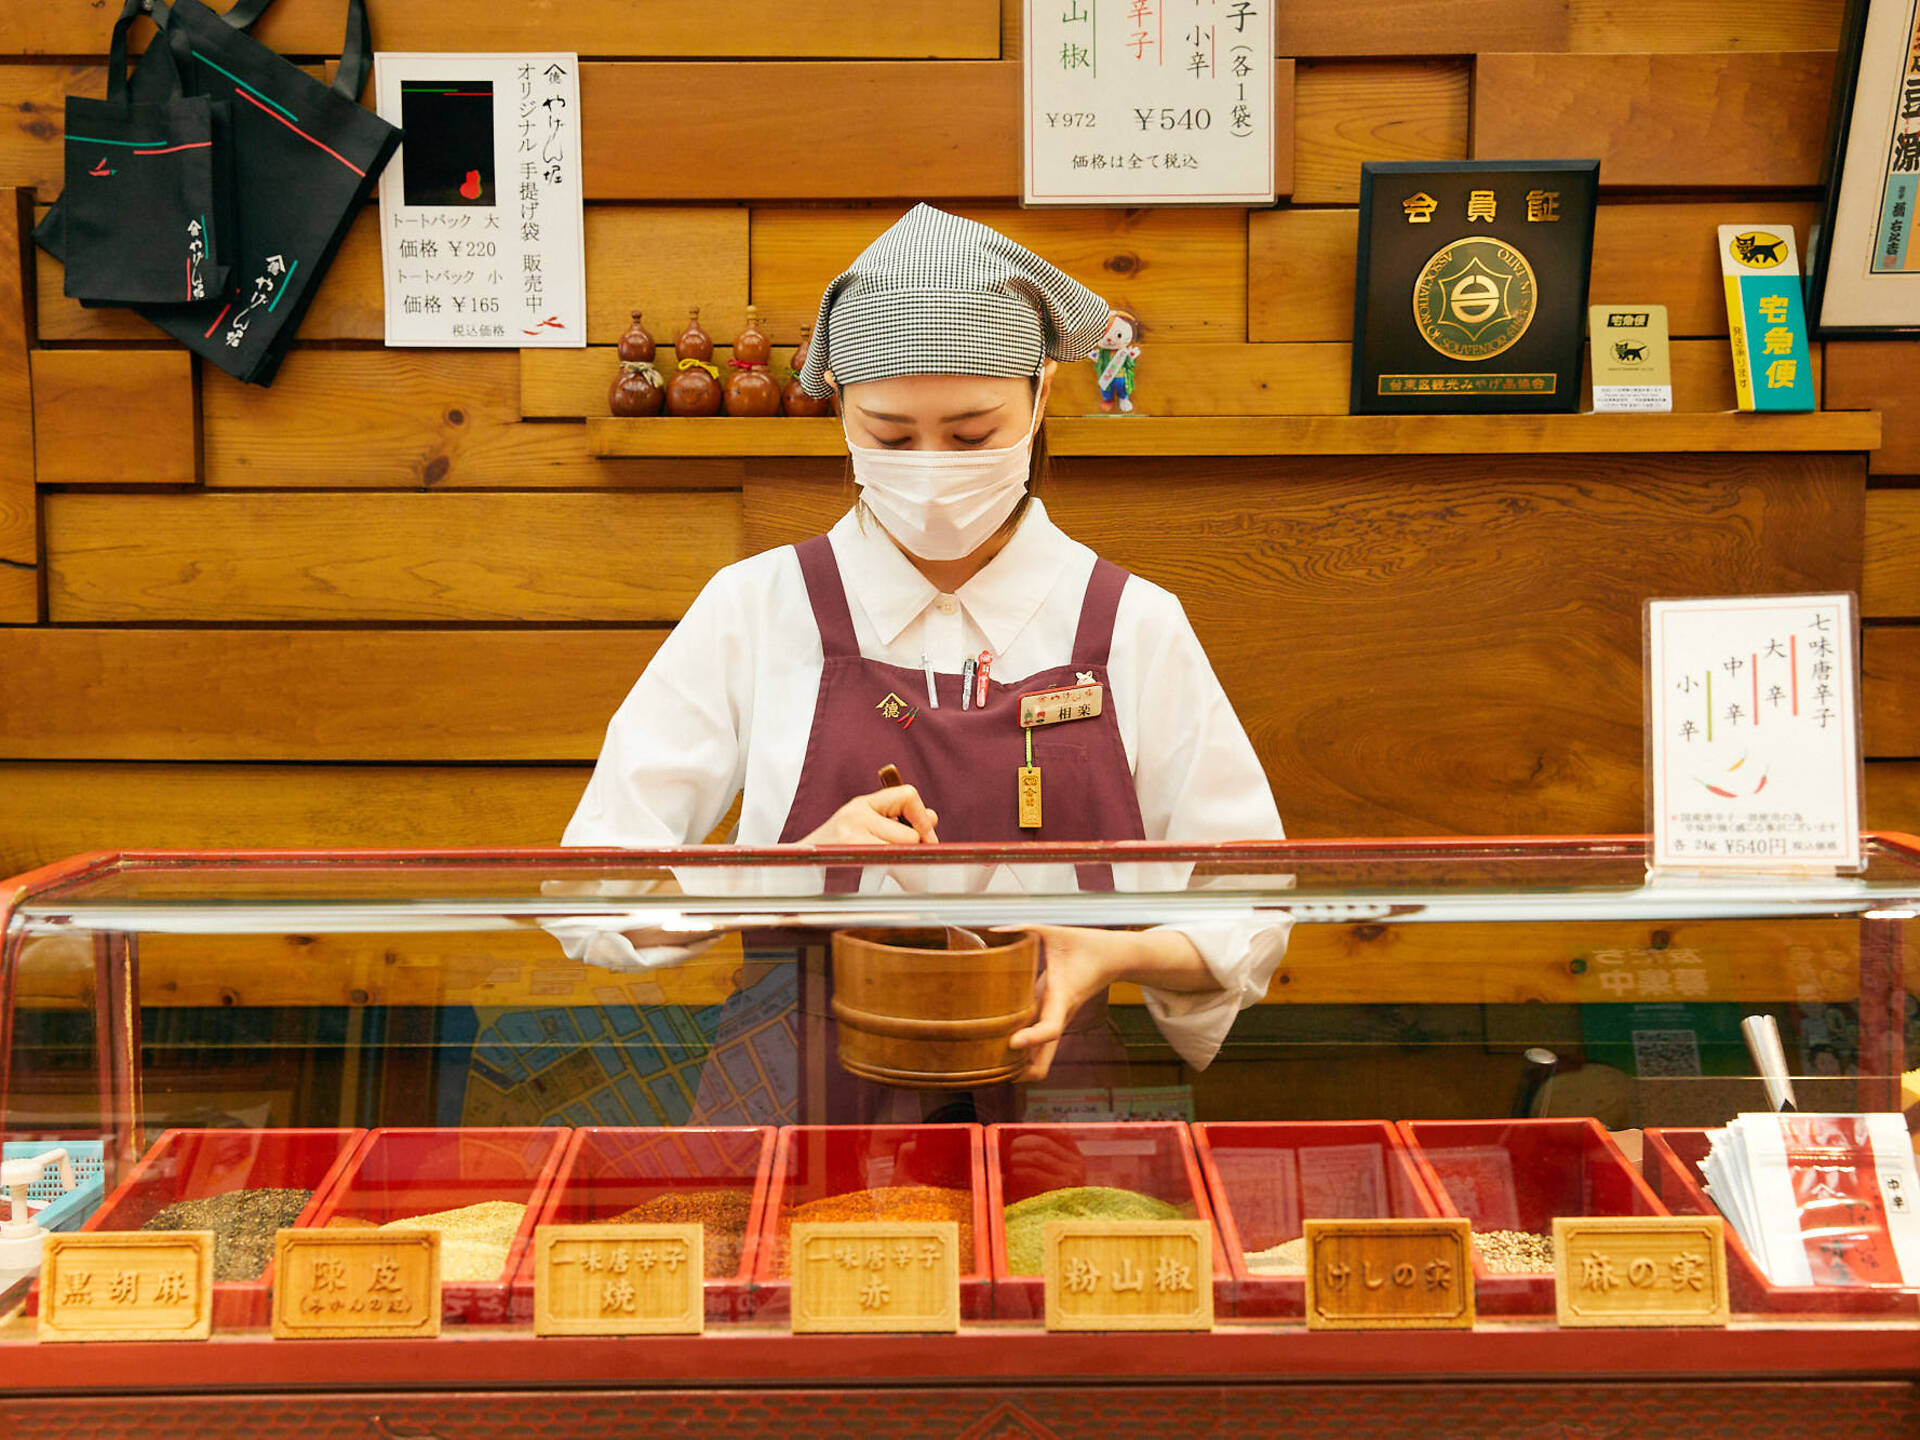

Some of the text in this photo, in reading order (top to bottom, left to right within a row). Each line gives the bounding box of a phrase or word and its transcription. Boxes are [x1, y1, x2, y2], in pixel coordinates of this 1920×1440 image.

[1060, 0, 1090, 70] 山椒
[1186, 25, 1210, 79] 小辛
[1046, 112, 1096, 128] ¥972
[1134, 108, 1211, 131] ¥540
[1072, 153, 1199, 170] 価格は全て税込
[518, 63, 543, 315] オリジナル 手提げ袋 販売中
[1402, 189, 1561, 224] 会員証
[485, 215, 500, 230] 大
[400, 239, 496, 259] 価格 ¥220
[488, 270, 503, 285] 小
[1418, 250, 1453, 325] ASSOCIATION
[1498, 249, 1526, 278] TAITO
[404, 295, 500, 314] 価格 ¥165
[452, 324, 505, 337] 税込価格
[1758, 294, 1797, 389] 宅急便
[1765, 638, 1787, 708] 大辛
[1808, 613, 1836, 729] 七味唐辛子
[1677, 675, 1700, 742] 小辛
[1723, 656, 1745, 726] 中辛
[552, 1245, 687, 1273] 一味唐辛子
[807, 1243, 942, 1272] 一味唐辛子
[1063, 1256, 1195, 1294] 粉山椒
[1578, 1251, 1705, 1294] 麻の実
[62, 1270, 190, 1307] 黒胡麻
[312, 1257, 403, 1294] 陳皮
[1326, 1259, 1453, 1293] けしの実
[602, 1278, 635, 1313] 焼
[859, 1276, 892, 1311] 赤
